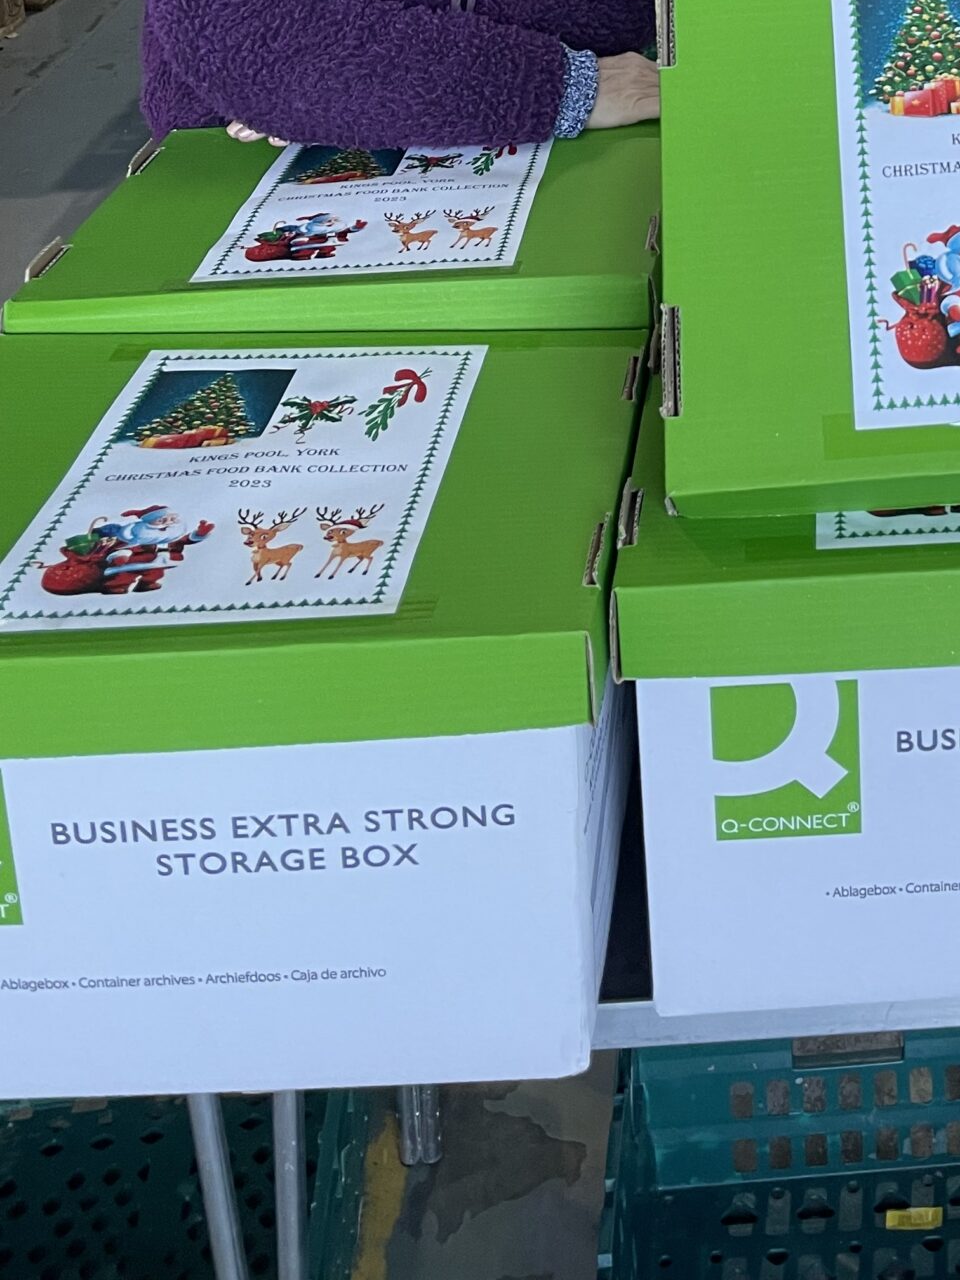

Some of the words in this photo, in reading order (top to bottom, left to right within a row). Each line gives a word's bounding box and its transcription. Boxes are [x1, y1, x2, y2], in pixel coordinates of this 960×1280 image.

[432, 183, 511, 192] COLLECTION
[188, 453, 239, 464] KINGS
[296, 447, 341, 456] YORK
[104, 469, 202, 482] CHRISTMAS
[206, 466, 251, 475] FOOD
[254, 464, 301, 474] BANK
[306, 463, 409, 473] COLLECTION
[228, 479, 272, 488] 2023
[50, 816, 217, 845] BUSINESS
[231, 812, 351, 839] EXTRA
[364, 803, 516, 833] STRONG
[156, 848, 326, 876] STORAGE
[341, 843, 420, 869] BOX
[832, 884, 897, 899] Ablagebox
[0, 978, 69, 992] Ablagebox
[78, 976, 140, 989] Container
[143, 973, 196, 987] archives
[205, 970, 282, 985] Archiefdoos
[290, 969, 319, 982] Caja
[320, 967, 338, 980] de
[340, 966, 387, 979] archivo
